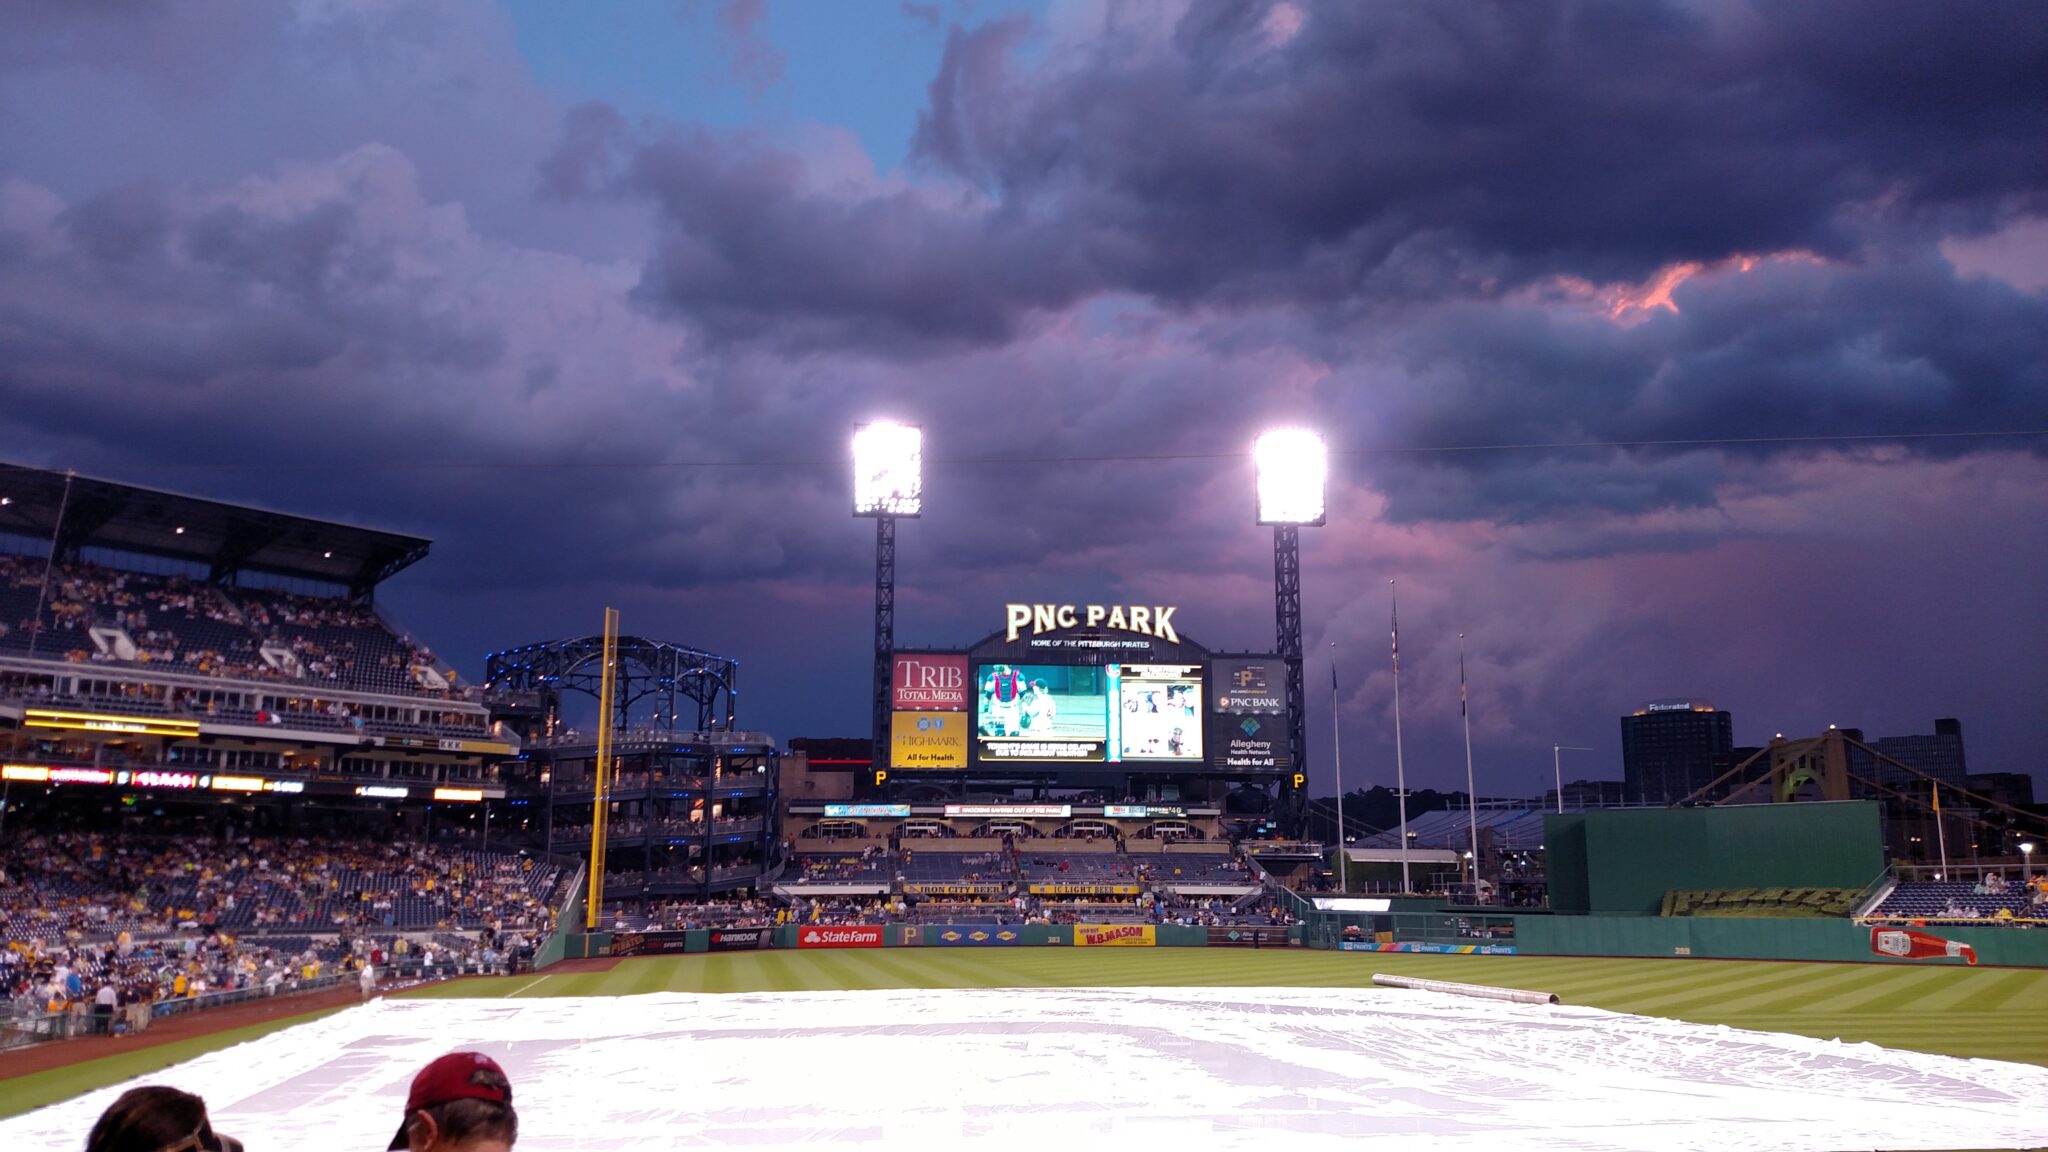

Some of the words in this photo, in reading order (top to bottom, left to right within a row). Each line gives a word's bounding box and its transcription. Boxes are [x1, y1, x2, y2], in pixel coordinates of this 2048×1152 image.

[1005, 603, 1079, 643] PNC
[1086, 604, 1181, 645] PARK
[1031, 639, 1052, 647] HOME
[1052, 639, 1062, 647] OF
[1063, 639, 1077, 648] THE
[1077, 640, 1121, 648] PITTSBURGH
[1121, 641, 1150, 649] PIRATES
[896, 660, 963, 688] TRIB
[897, 688, 931, 700] TOTAL
[931, 689, 963, 700] MEDIA
[1230, 697, 1252, 707] PNC
[1252, 698, 1280, 707] BANK
[1648, 702, 1690, 711] Federated
[1230, 740, 1272, 749] Allegheny
[1227, 757, 1251, 766] Health
[1252, 758, 1262, 766] for
[1263, 758, 1274, 766] All
[876, 770, 887, 786] P
[1294, 774, 1305, 788] P
[920, 885, 943, 894] IRON
[948, 885, 970, 894] CITY
[973, 885, 1000, 894] BEER
[1064, 885, 1091, 893] LIGHT
[1094, 885, 1114, 893] BEER
[904, 927, 917, 945] P
